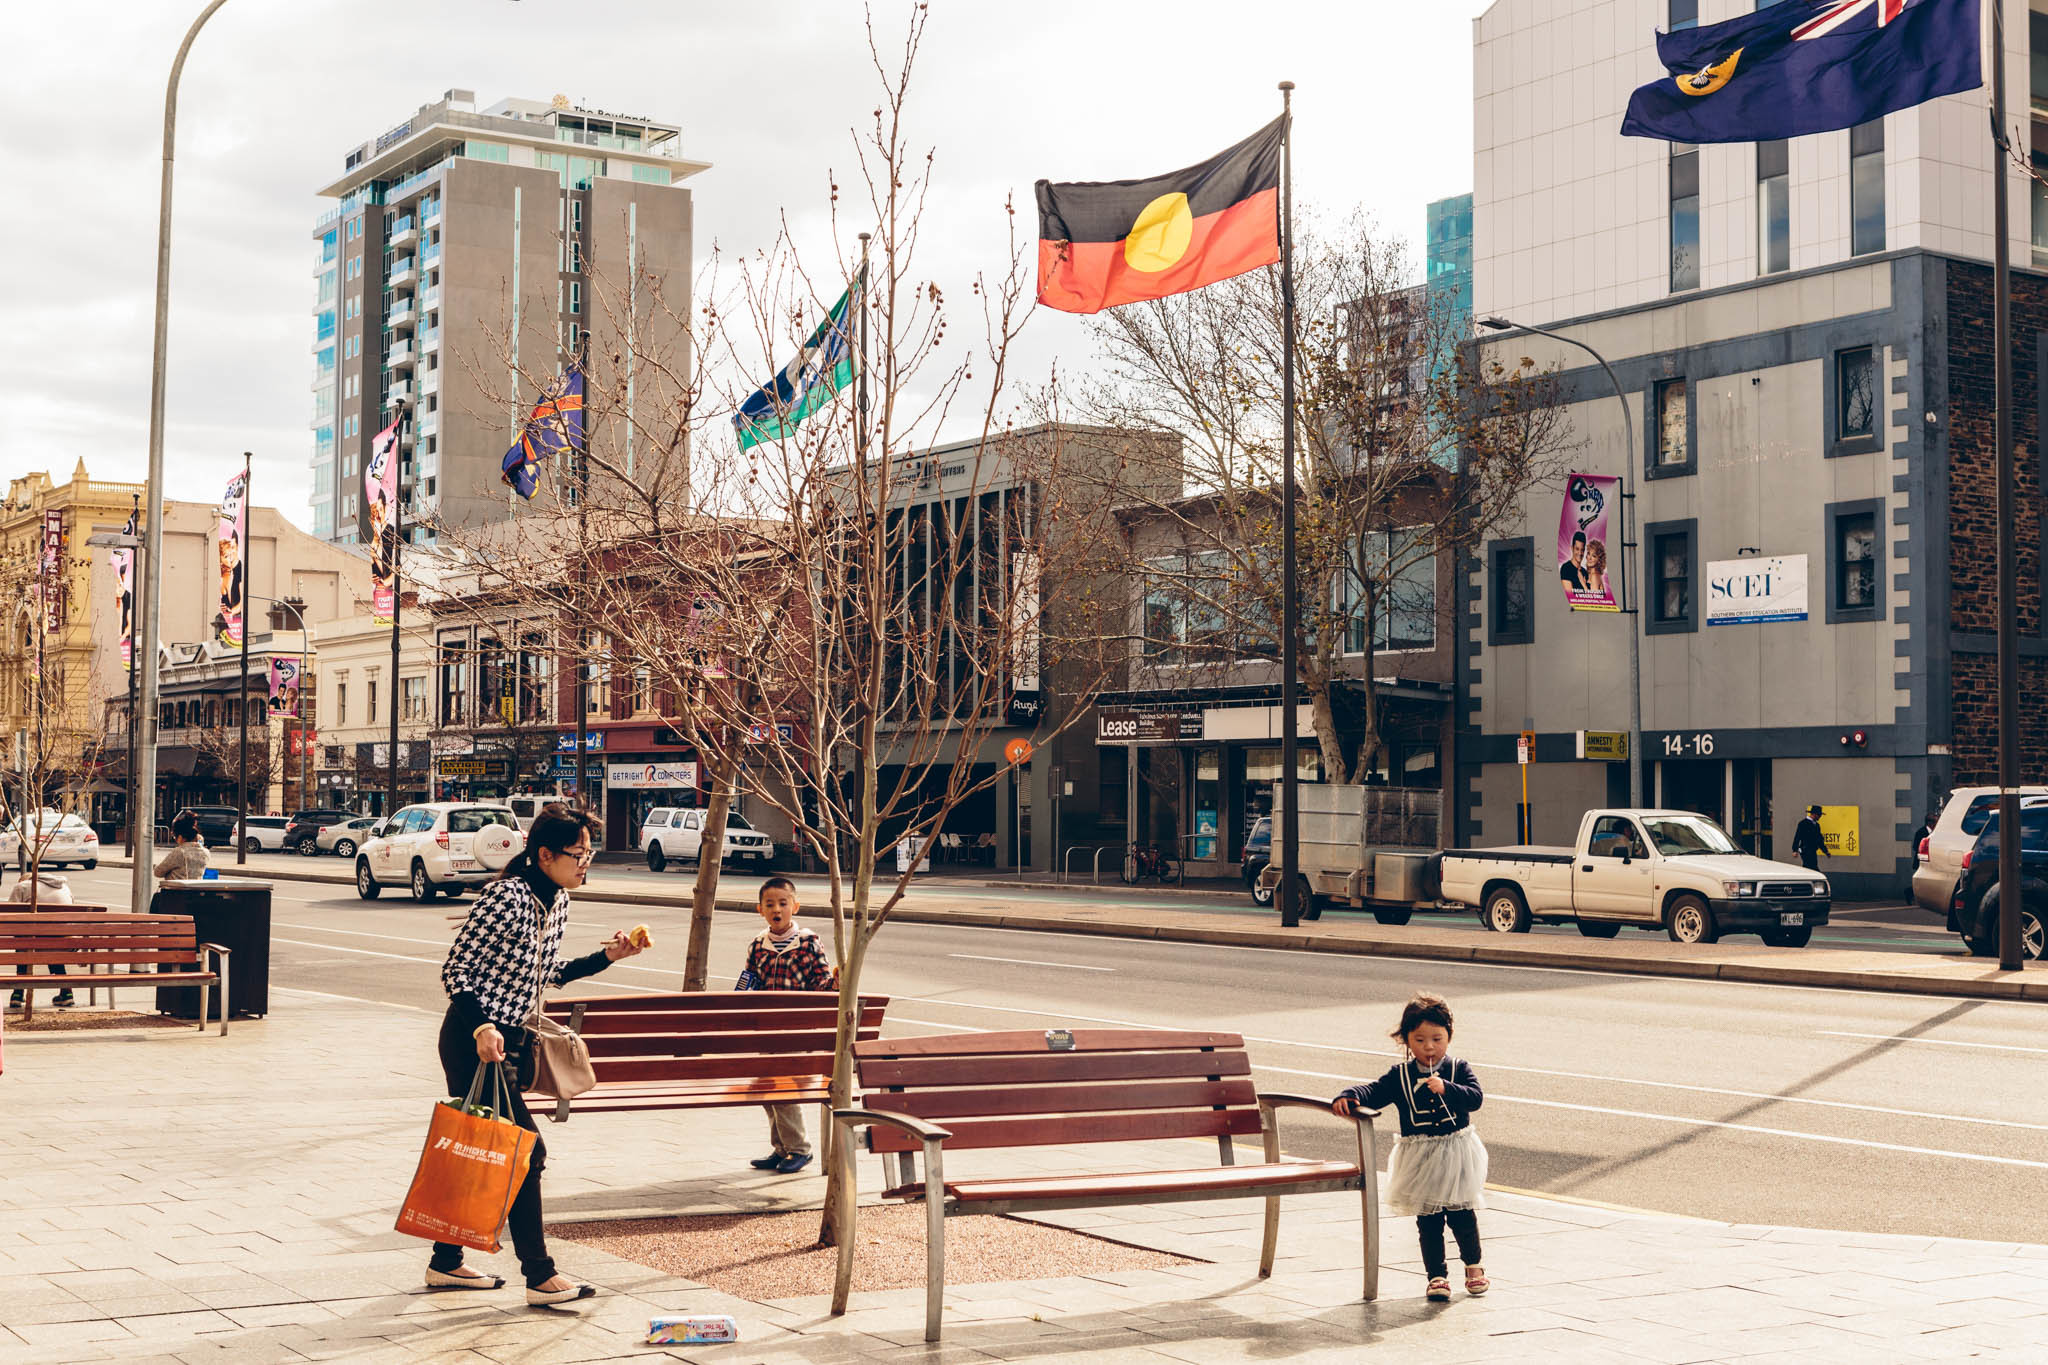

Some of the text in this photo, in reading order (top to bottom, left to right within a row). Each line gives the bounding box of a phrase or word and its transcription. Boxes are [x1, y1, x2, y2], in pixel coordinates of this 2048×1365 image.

[1711, 574, 1771, 600] SCEI
[1100, 716, 1137, 737] Lease
[1587, 735, 1613, 746] AMNESTY
[612, 771, 644, 782] GETRIGHT
[657, 770, 692, 781] COMPUTERS
[1823, 833, 1841, 843] ESTY
